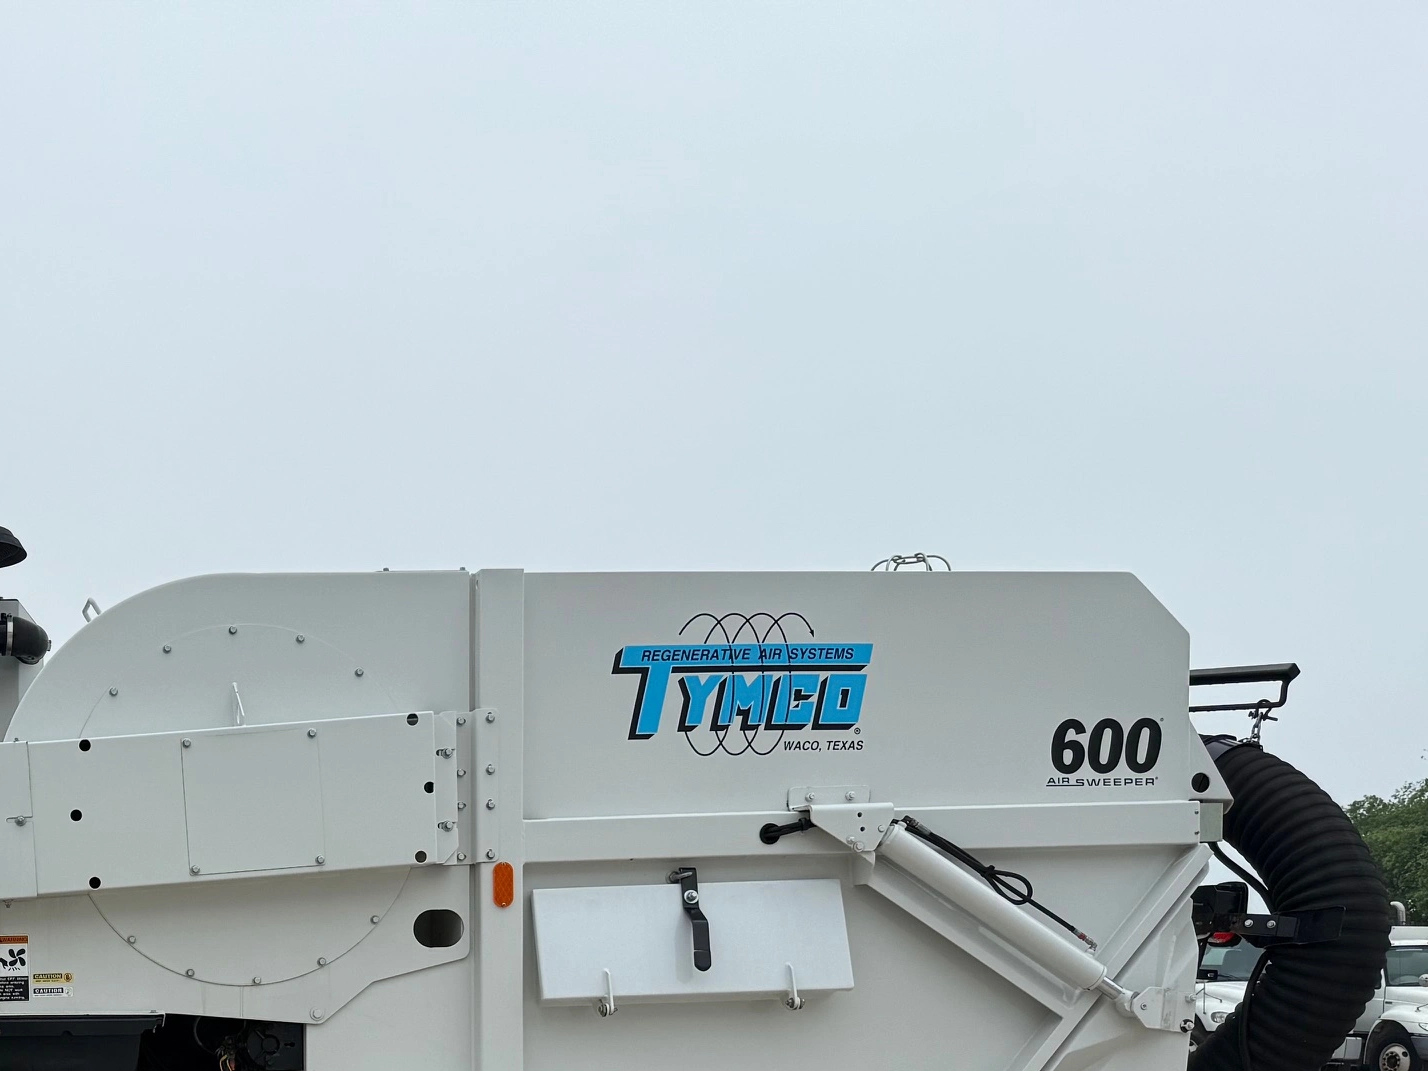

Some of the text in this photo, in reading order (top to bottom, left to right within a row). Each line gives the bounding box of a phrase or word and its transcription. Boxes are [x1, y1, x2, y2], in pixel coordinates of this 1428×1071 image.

[641, 647, 854, 662] REGENERATIVE AIR SYSTEMS
[611, 643, 874, 740] TYMCO
[783, 740, 864, 752] WACO, TEXAS
[1050, 717, 1162, 775] 600
[1047, 777, 1155, 787] AIR SWEEPER
